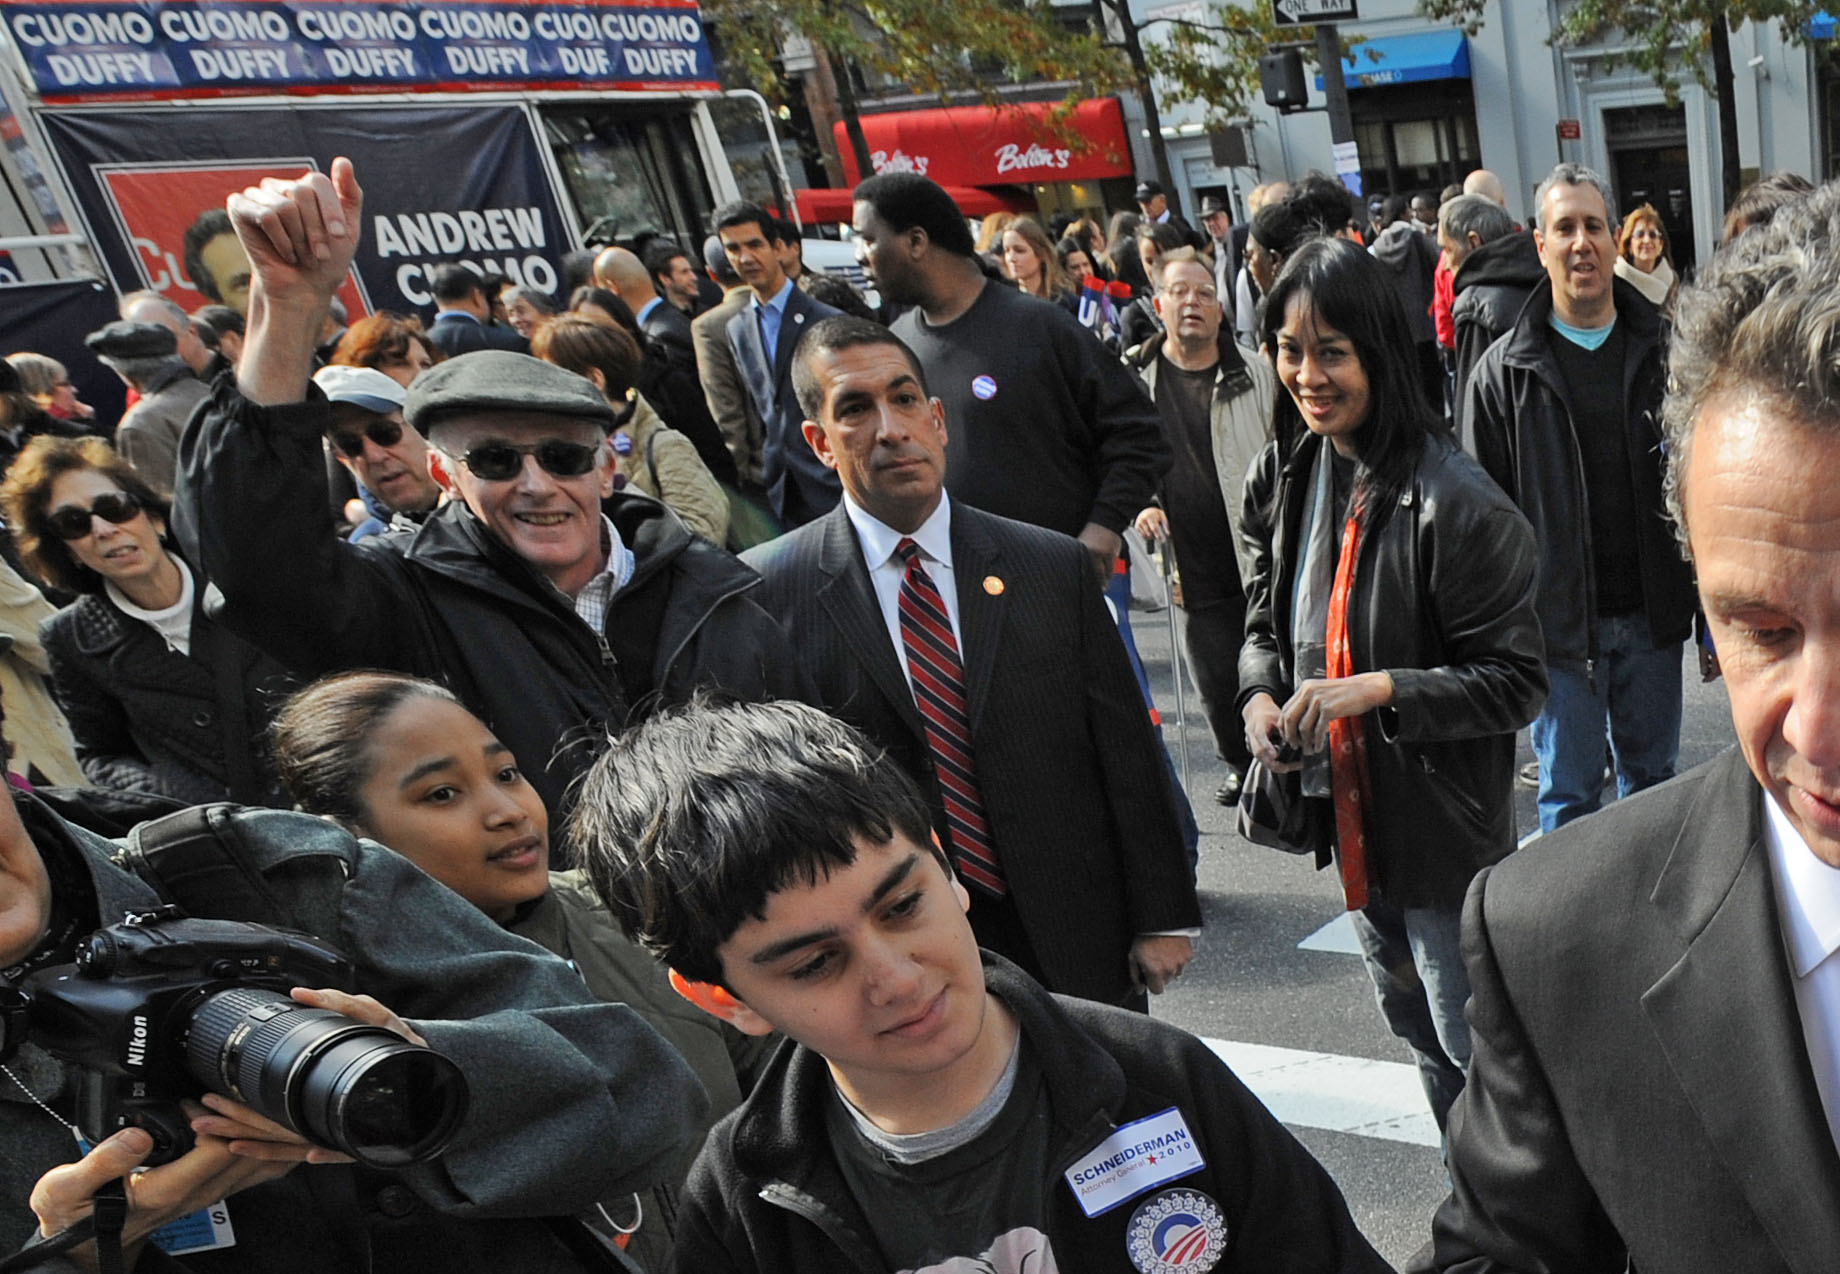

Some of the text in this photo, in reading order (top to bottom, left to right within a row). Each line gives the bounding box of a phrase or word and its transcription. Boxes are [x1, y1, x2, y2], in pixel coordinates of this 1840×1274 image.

[12, 14, 154, 47] CUOMO
[160, 10, 291, 42] CUOMO
[297, 10, 417, 41] CUOMO
[419, 10, 530, 41] CUOMO
[602, 13, 700, 43] CUOMO
[47, 52, 155, 86] DUFFY
[190, 50, 290, 79] DUFFY
[323, 48, 417, 78] DUFFY
[445, 46, 530, 76] DUFFY
[623, 48, 699, 76] DUFFY
[995, 143, 1070, 174] Bolton's
[374, 207, 546, 258] ANDREW
[127, 1015, 147, 1066] Nikon
[1074, 1128, 1187, 1185] SCHNEIDERMAN
[1080, 1141, 1192, 1196] Attorney General 2010
